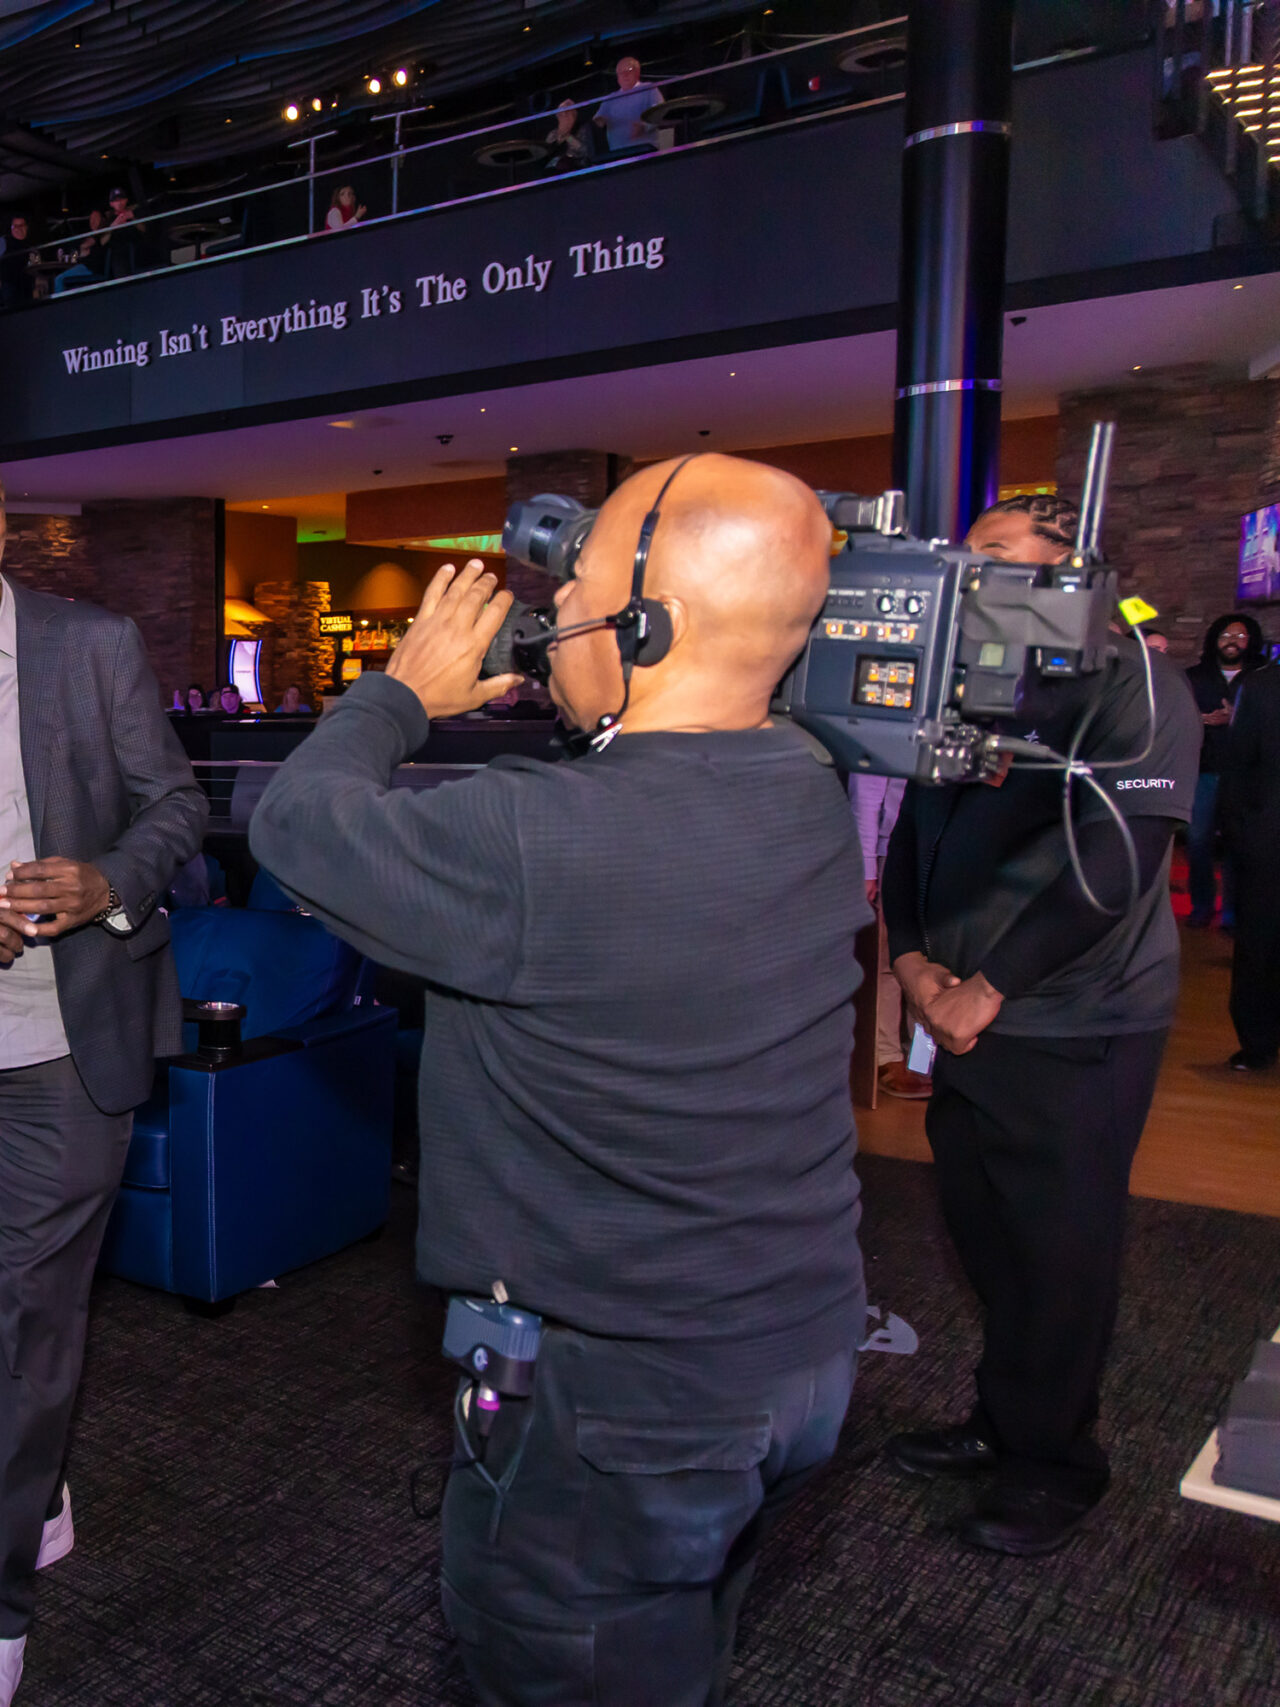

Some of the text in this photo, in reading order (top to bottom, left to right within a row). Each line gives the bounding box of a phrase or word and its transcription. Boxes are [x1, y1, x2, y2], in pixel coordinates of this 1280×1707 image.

[63, 235, 665, 374] Winning Isn't Everything It's The Only Thing
[320, 616, 352, 624] VIRTUAL
[320, 624, 352, 632] CASHIER
[1116, 778, 1176, 790] SECURITY
